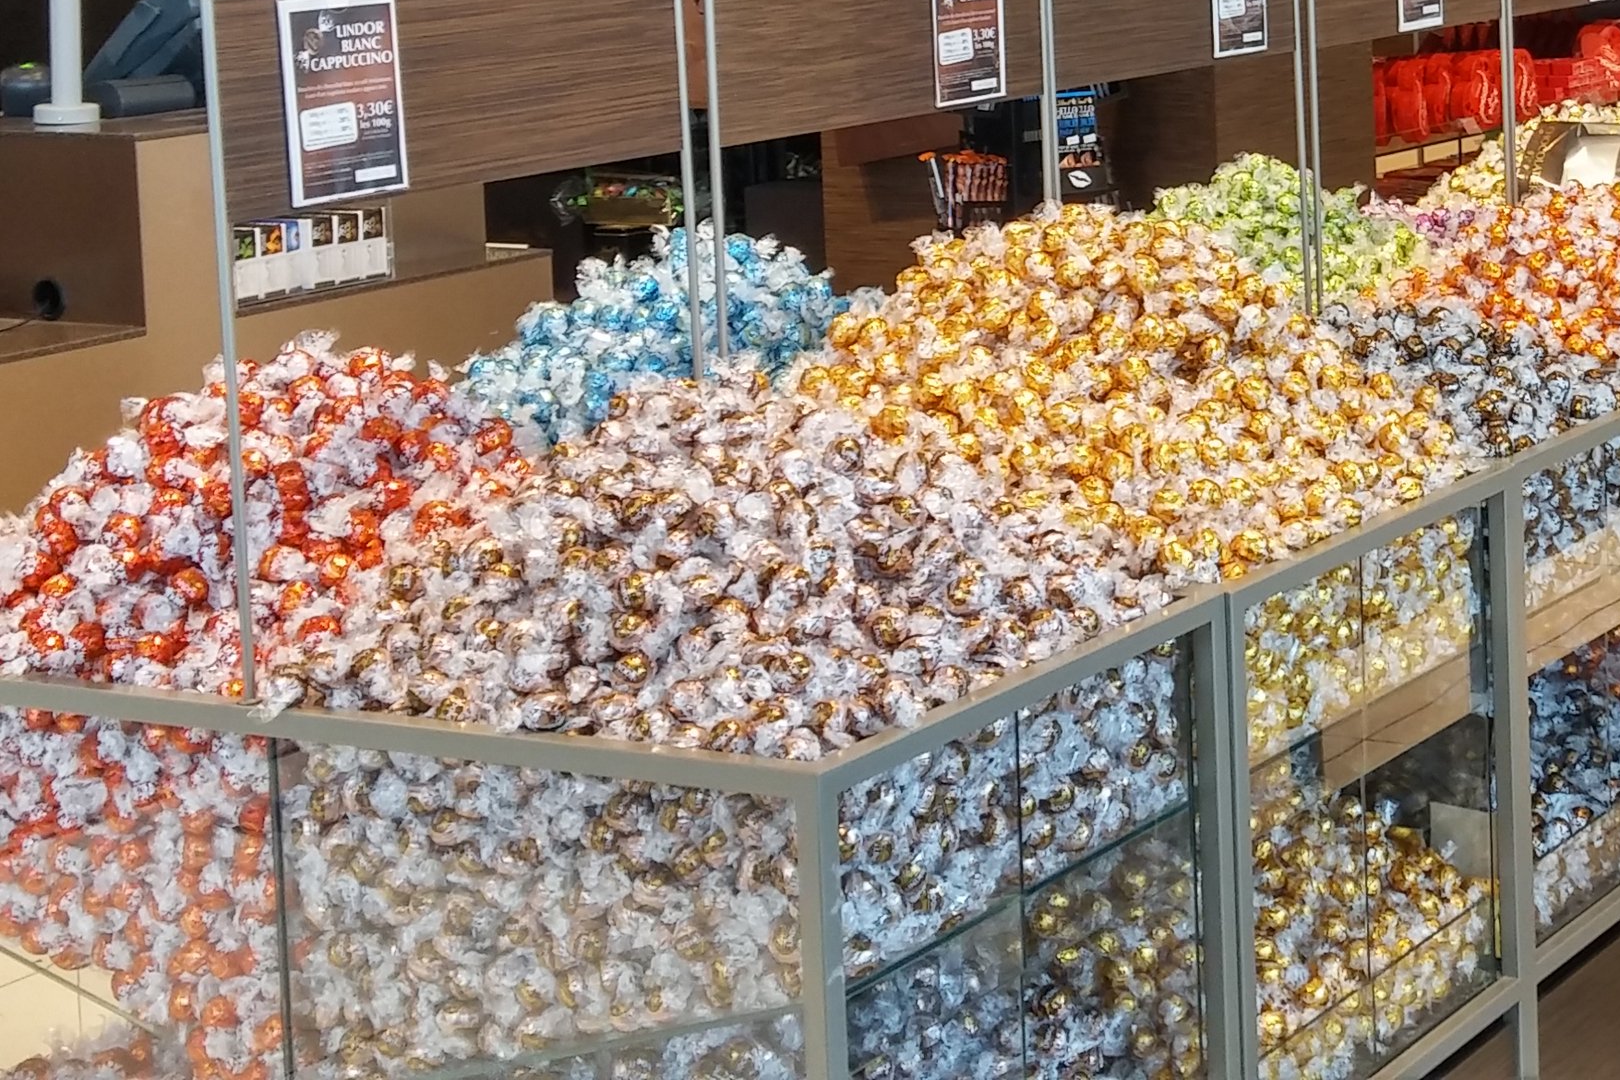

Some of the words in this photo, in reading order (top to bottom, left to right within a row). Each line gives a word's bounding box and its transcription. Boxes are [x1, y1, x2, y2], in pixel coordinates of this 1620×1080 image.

[335, 20, 385, 39] LINDOR
[341, 36, 381, 53] BLANC
[310, 50, 393, 72] CAPPUCCINO
[356, 100, 394, 119] 3,30€
